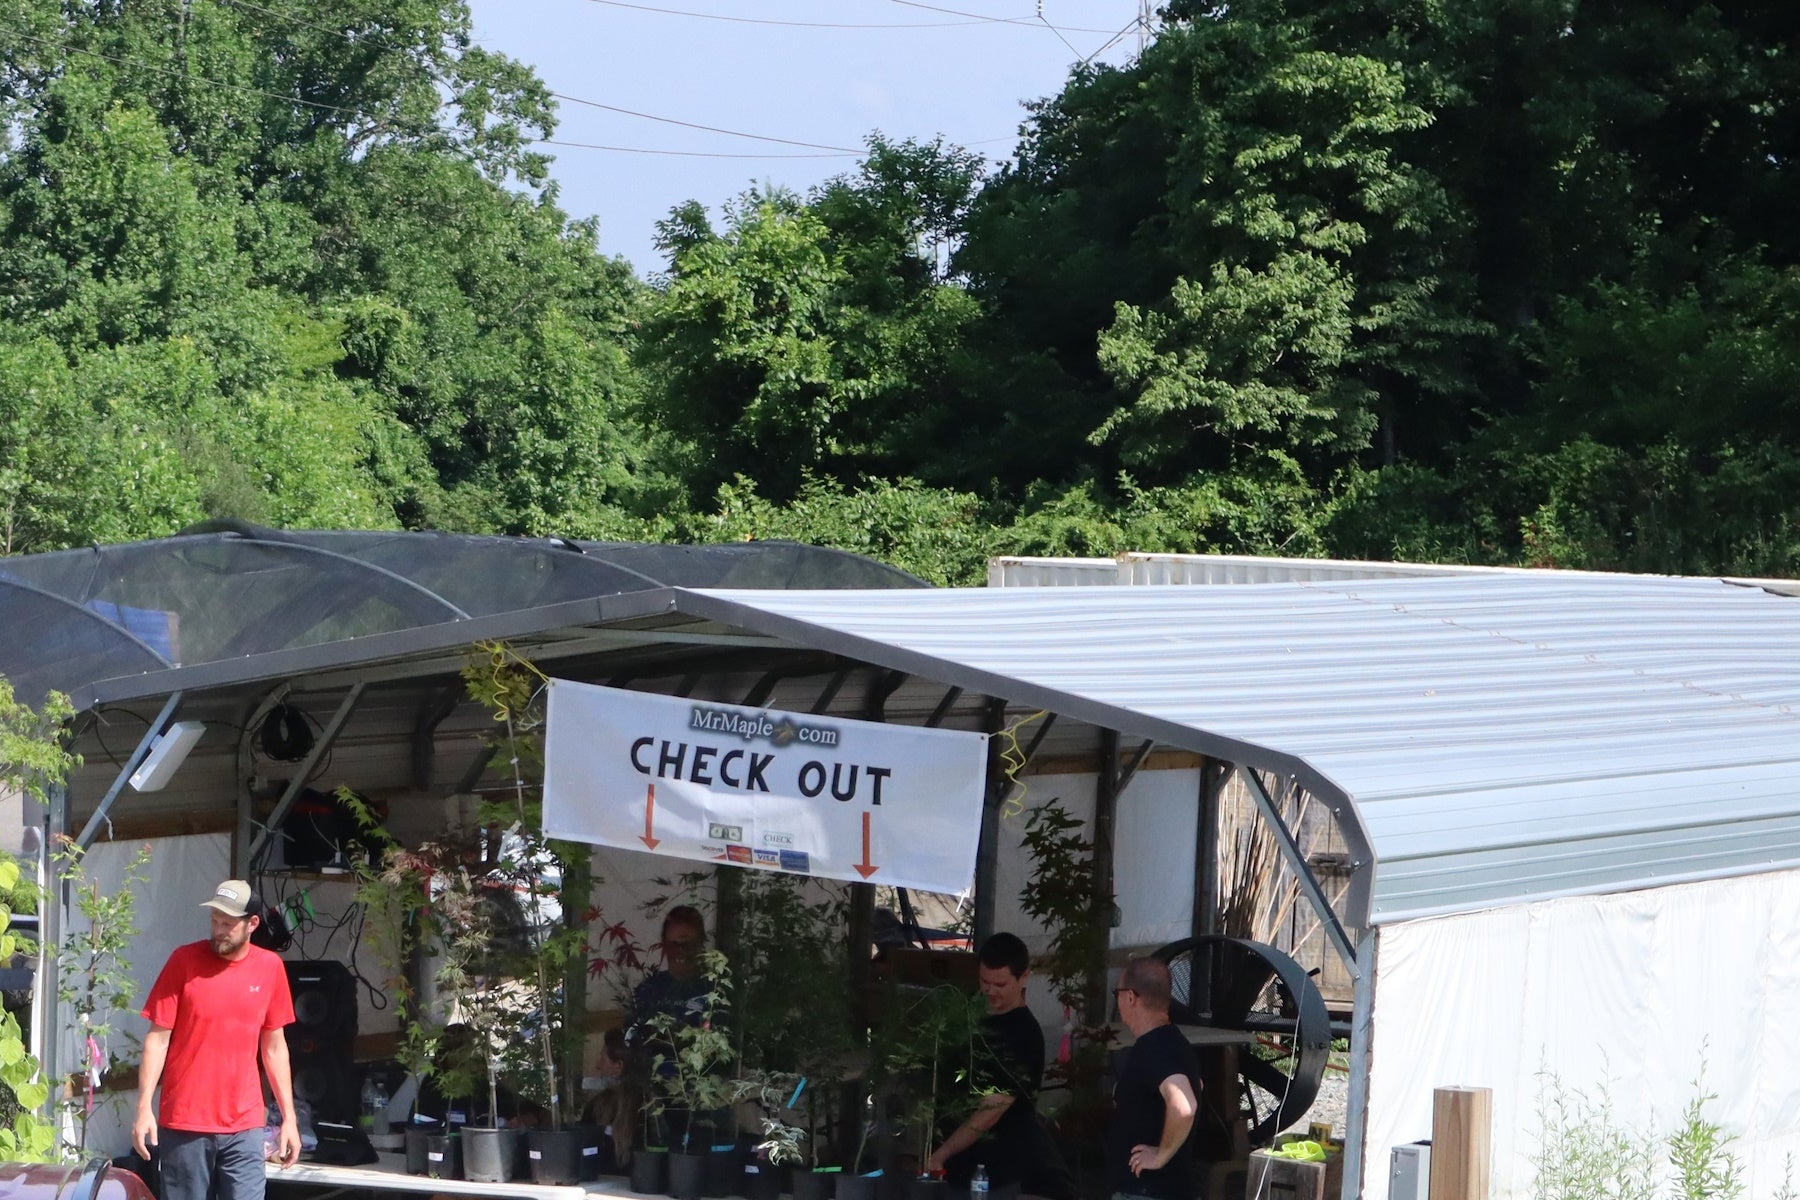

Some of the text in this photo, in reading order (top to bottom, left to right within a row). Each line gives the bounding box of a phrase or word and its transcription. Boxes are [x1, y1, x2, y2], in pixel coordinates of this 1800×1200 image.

[692, 708, 774, 739] MrMaple
[631, 736, 892, 806] CHECK OUT
[763, 834, 792, 845] CHECK
[757, 853, 776, 863] VISA
